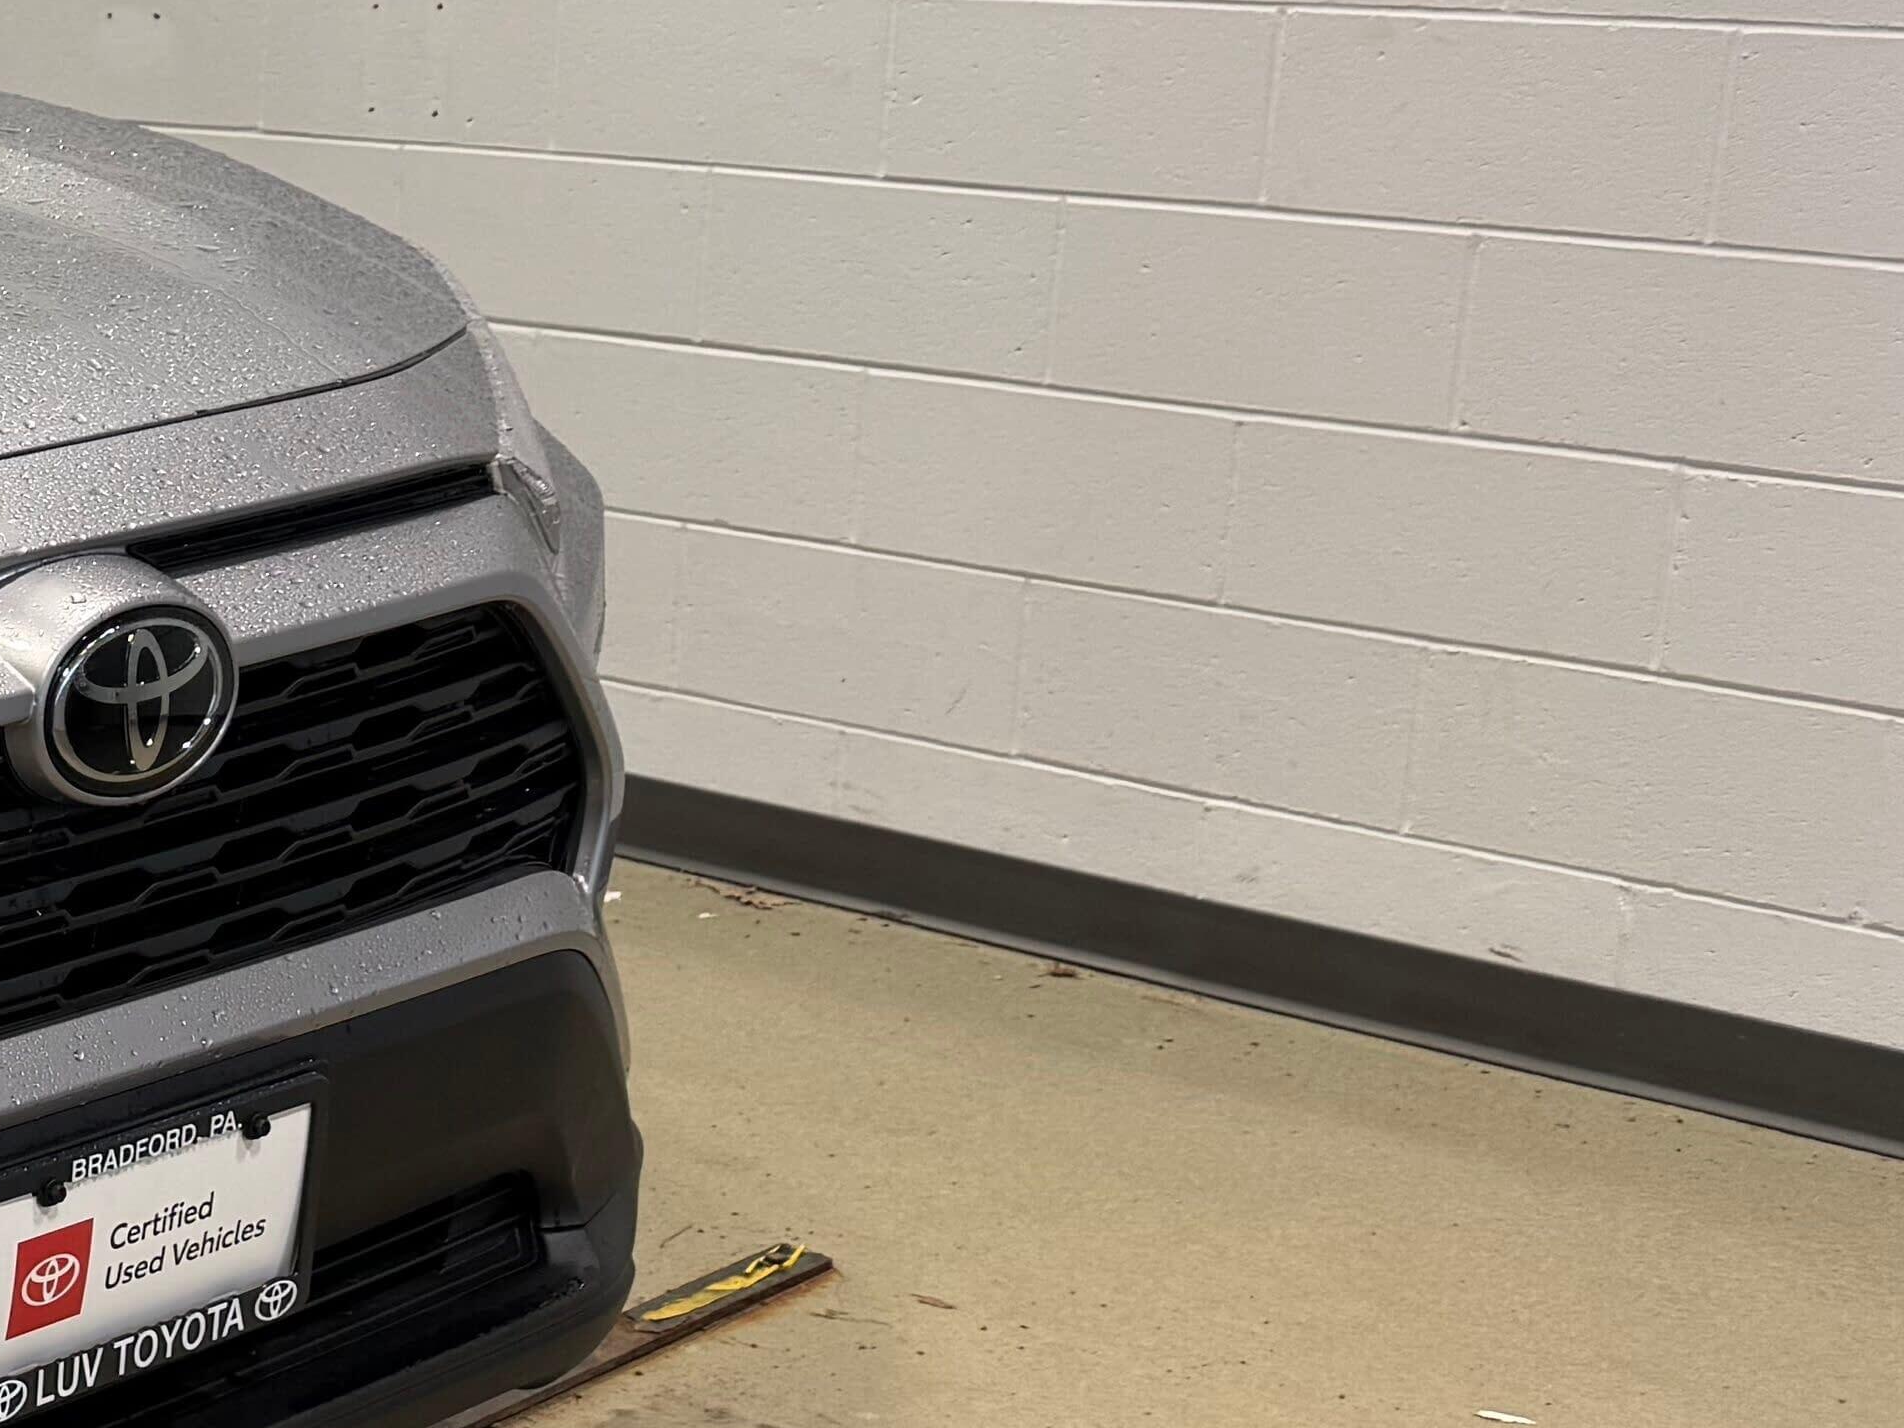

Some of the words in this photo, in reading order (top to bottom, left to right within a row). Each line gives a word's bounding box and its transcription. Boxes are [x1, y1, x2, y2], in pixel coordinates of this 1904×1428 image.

[209, 1109, 243, 1138] PA.
[104, 1252, 163, 1290] Used
[172, 1216, 267, 1266] Vehicles
[109, 1191, 215, 1250] Certified
[35, 1347, 105, 1407] LUV
[113, 1297, 245, 1377] TOYOTA
